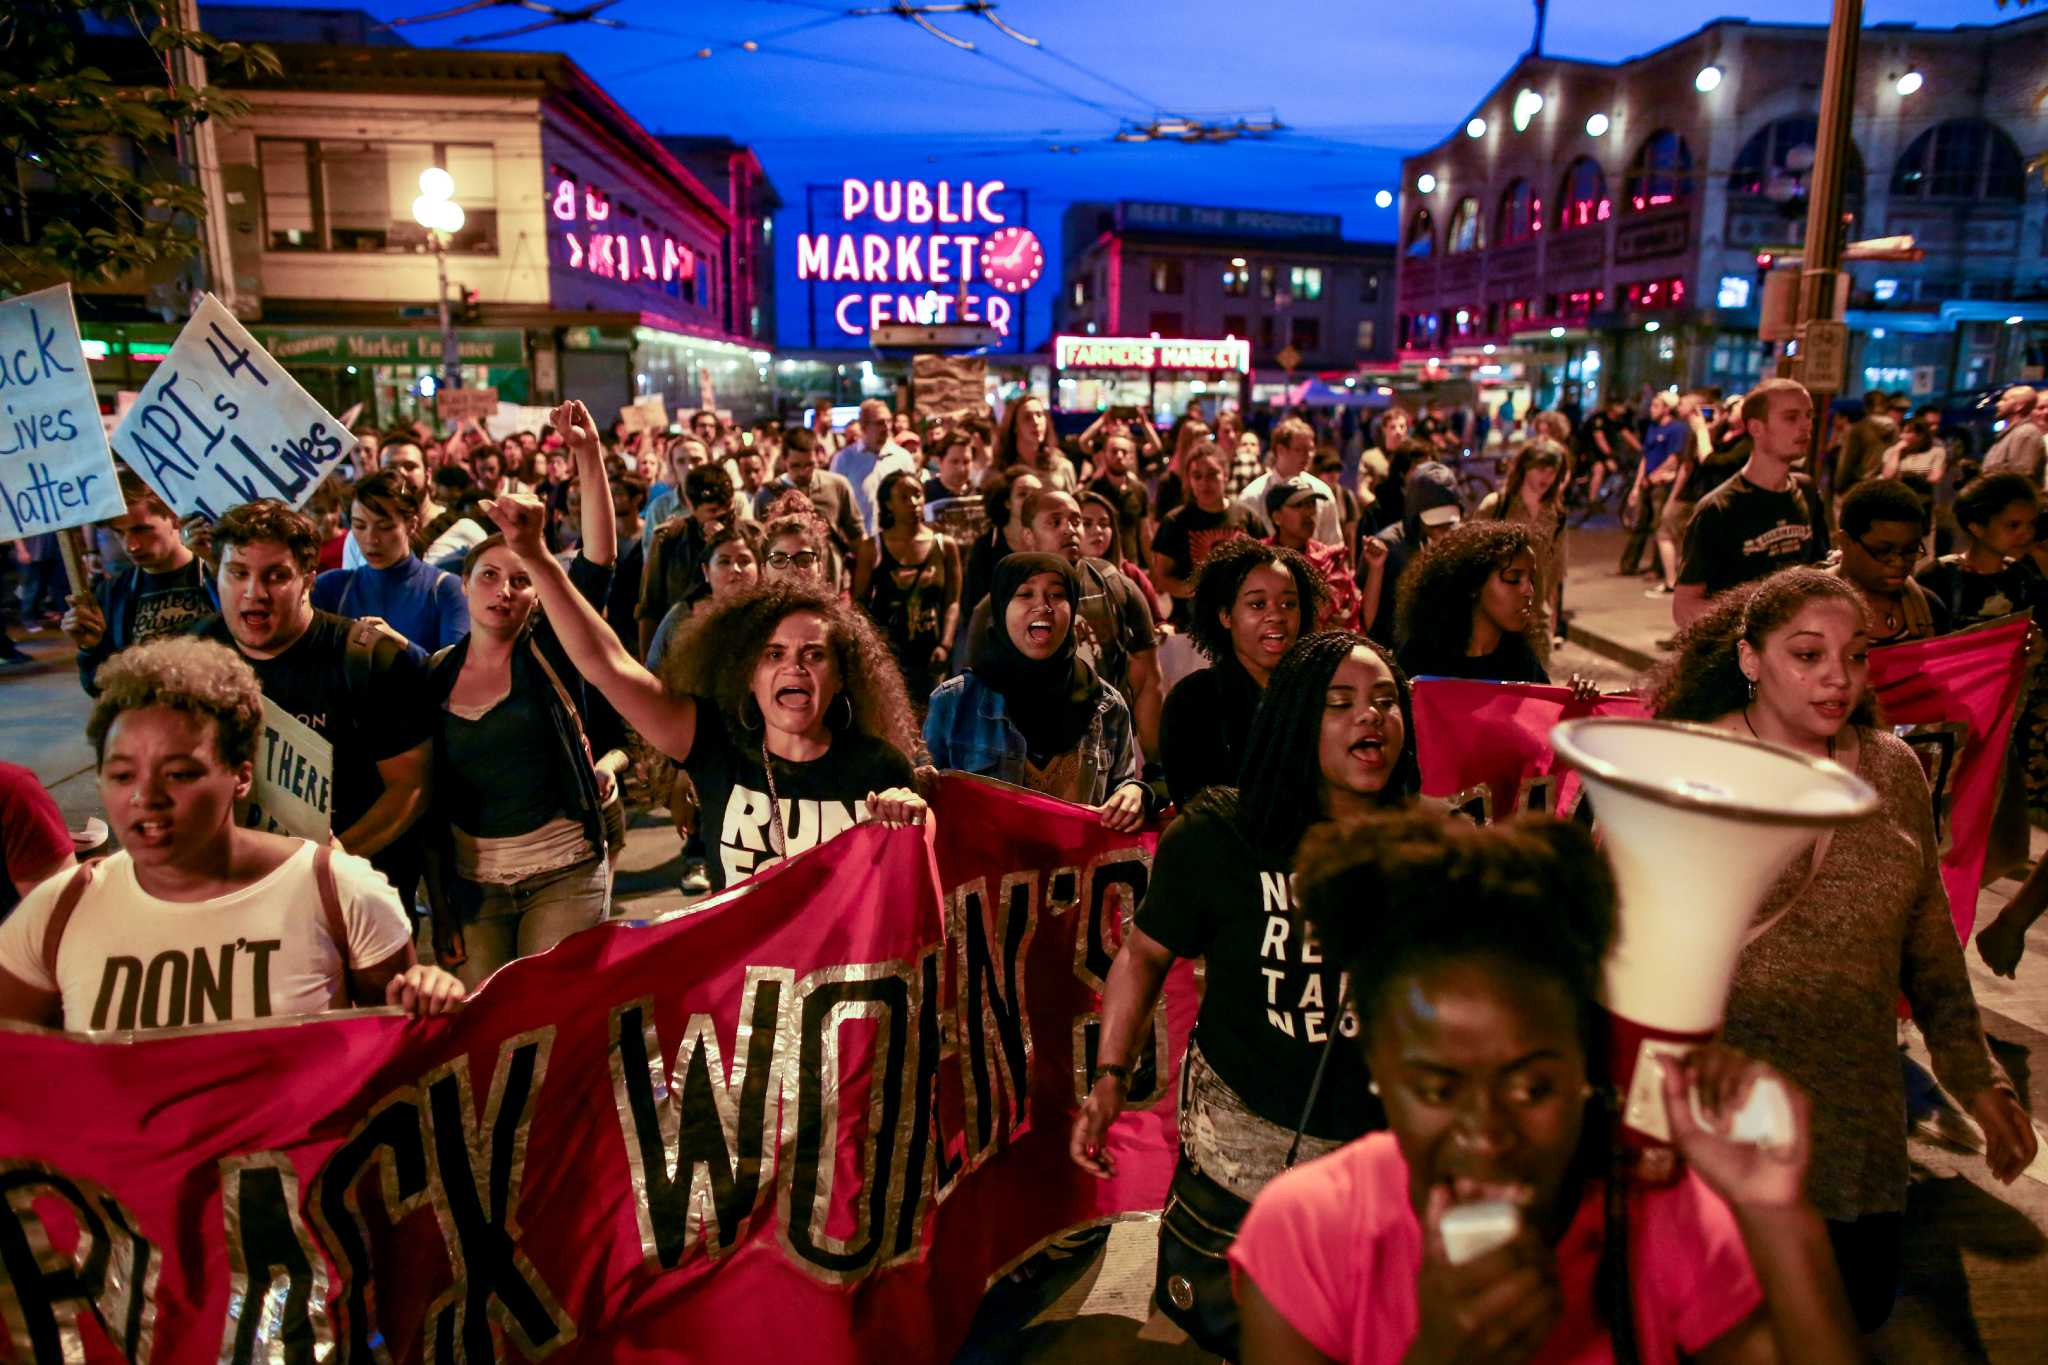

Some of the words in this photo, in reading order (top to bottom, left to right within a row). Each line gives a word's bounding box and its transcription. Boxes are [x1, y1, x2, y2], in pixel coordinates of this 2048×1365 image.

[842, 178, 1006, 224] PUBLIC
[797, 233, 980, 283] MARKET
[348, 335, 410, 357] Market
[1066, 345, 1155, 367] FARMERS
[1160, 346, 1240, 369] MARKET
[264, 726, 330, 814] THERE
[91, 938, 280, 1030] DON'T
